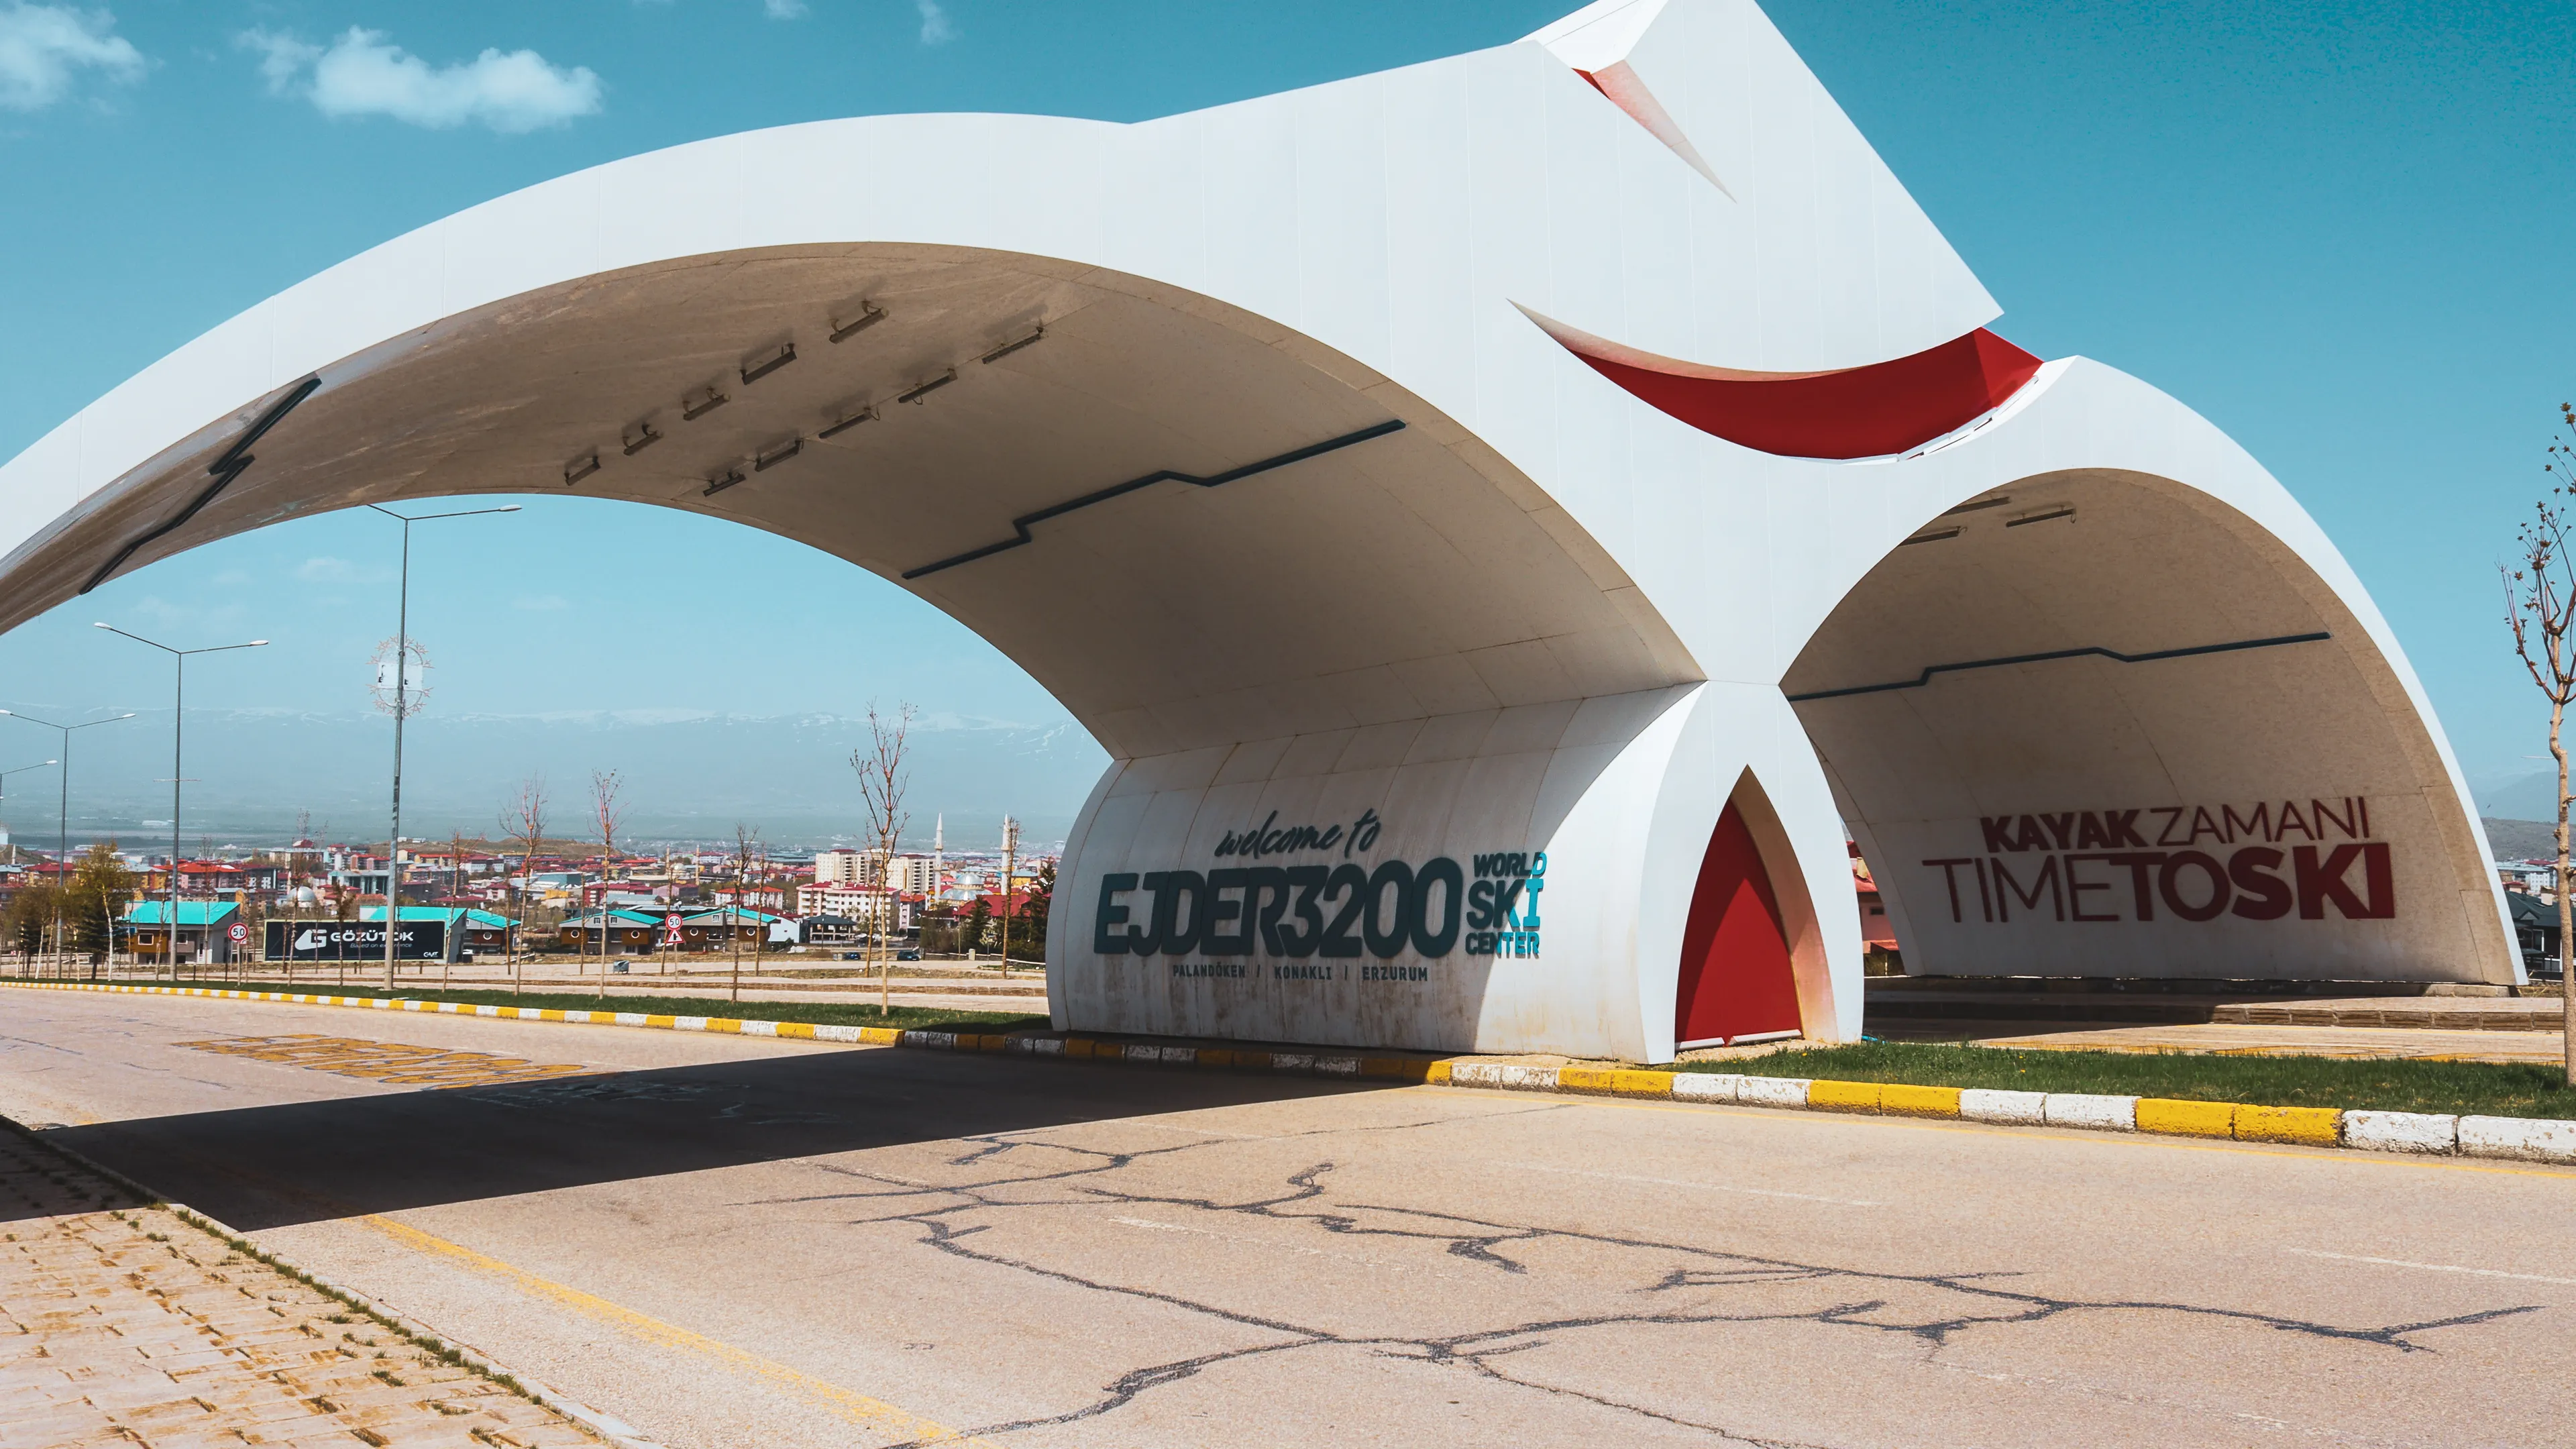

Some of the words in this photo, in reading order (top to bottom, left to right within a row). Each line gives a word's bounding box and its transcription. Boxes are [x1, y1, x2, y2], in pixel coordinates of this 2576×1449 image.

[1214, 809, 1343, 860] welcome
[1344, 807, 1382, 860] to
[1473, 852, 1547, 877] WORLD
[1093, 857, 1464, 959] EJDER3200
[1466, 878, 1544, 928] SKI
[233, 928, 245, 936] 50
[1465, 932, 1540, 955] CENTER
[1173, 963, 1246, 979] PALANDÖKEN
[1274, 965, 1332, 981] KONAKLI
[1362, 966, 1429, 982] ERZURUM
